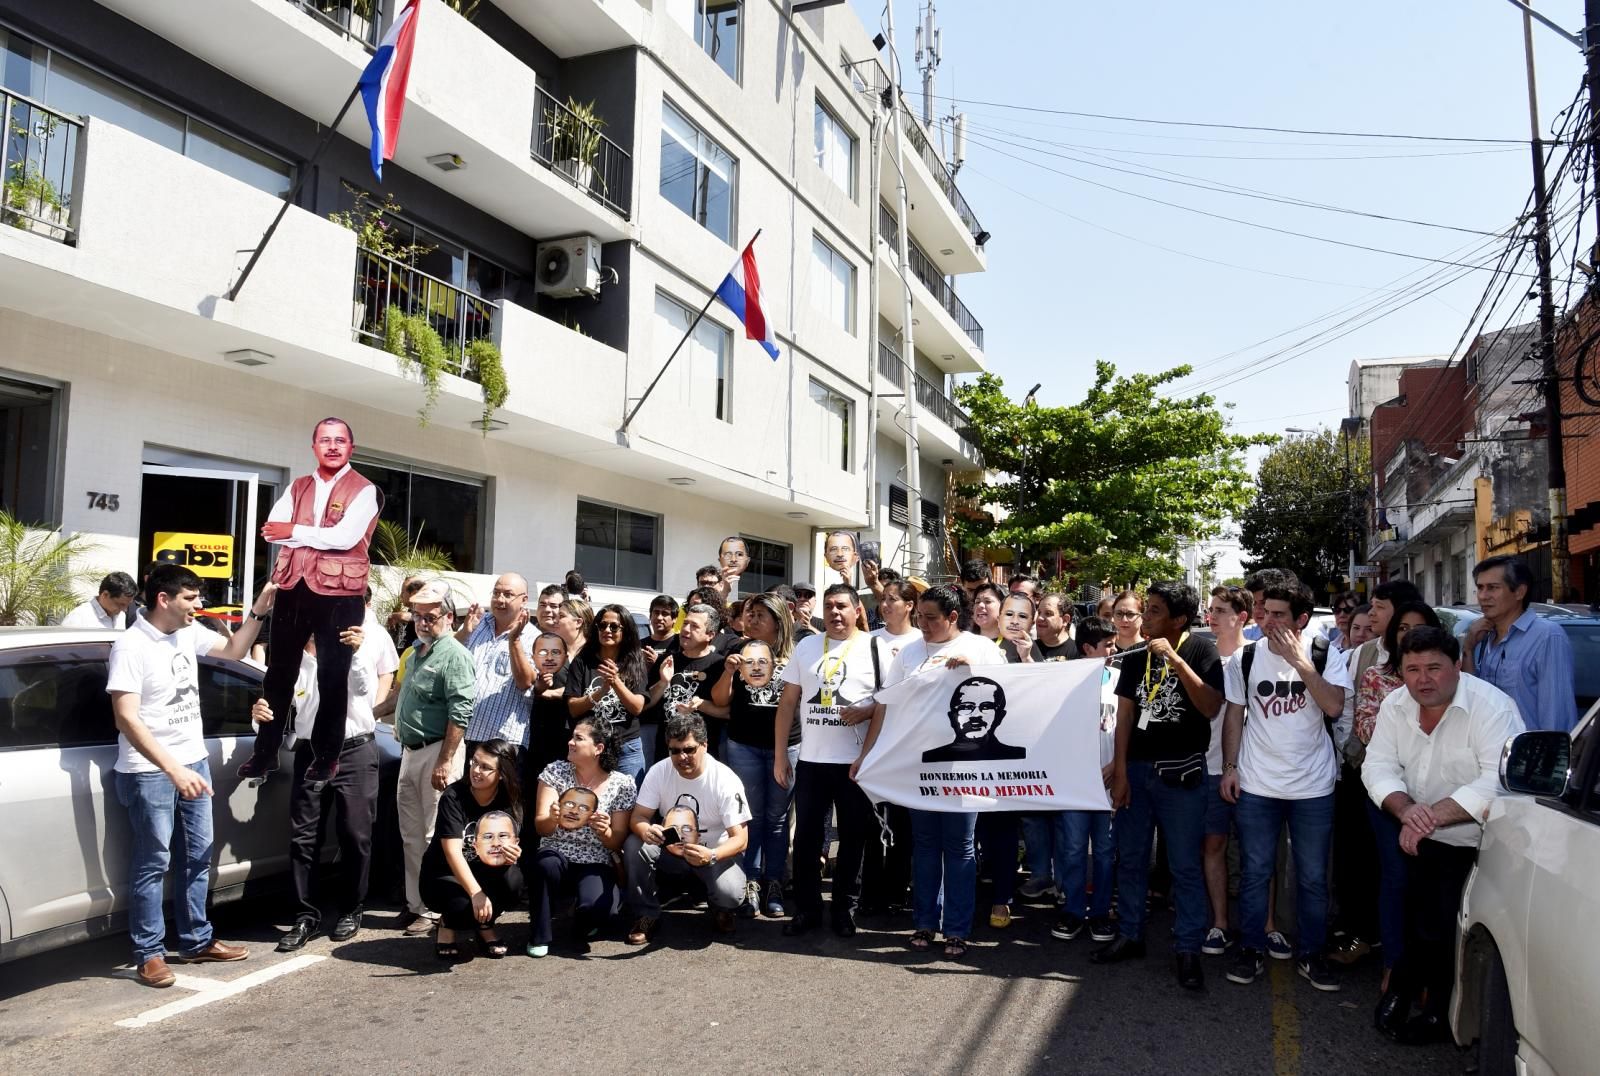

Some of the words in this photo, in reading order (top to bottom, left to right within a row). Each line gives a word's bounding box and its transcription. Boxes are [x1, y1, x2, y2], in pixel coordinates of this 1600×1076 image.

[86, 491, 120, 512] 745
[156, 543, 229, 567] abc
[809, 705, 841, 715] ¡Justici
[1254, 692, 1307, 719] Voice
[920, 772, 978, 781] HONREMOS
[981, 772, 994, 781] LA
[997, 770, 1048, 780] MEMORIA
[919, 786, 939, 796] DE
[994, 784, 1054, 797] MEDINA
